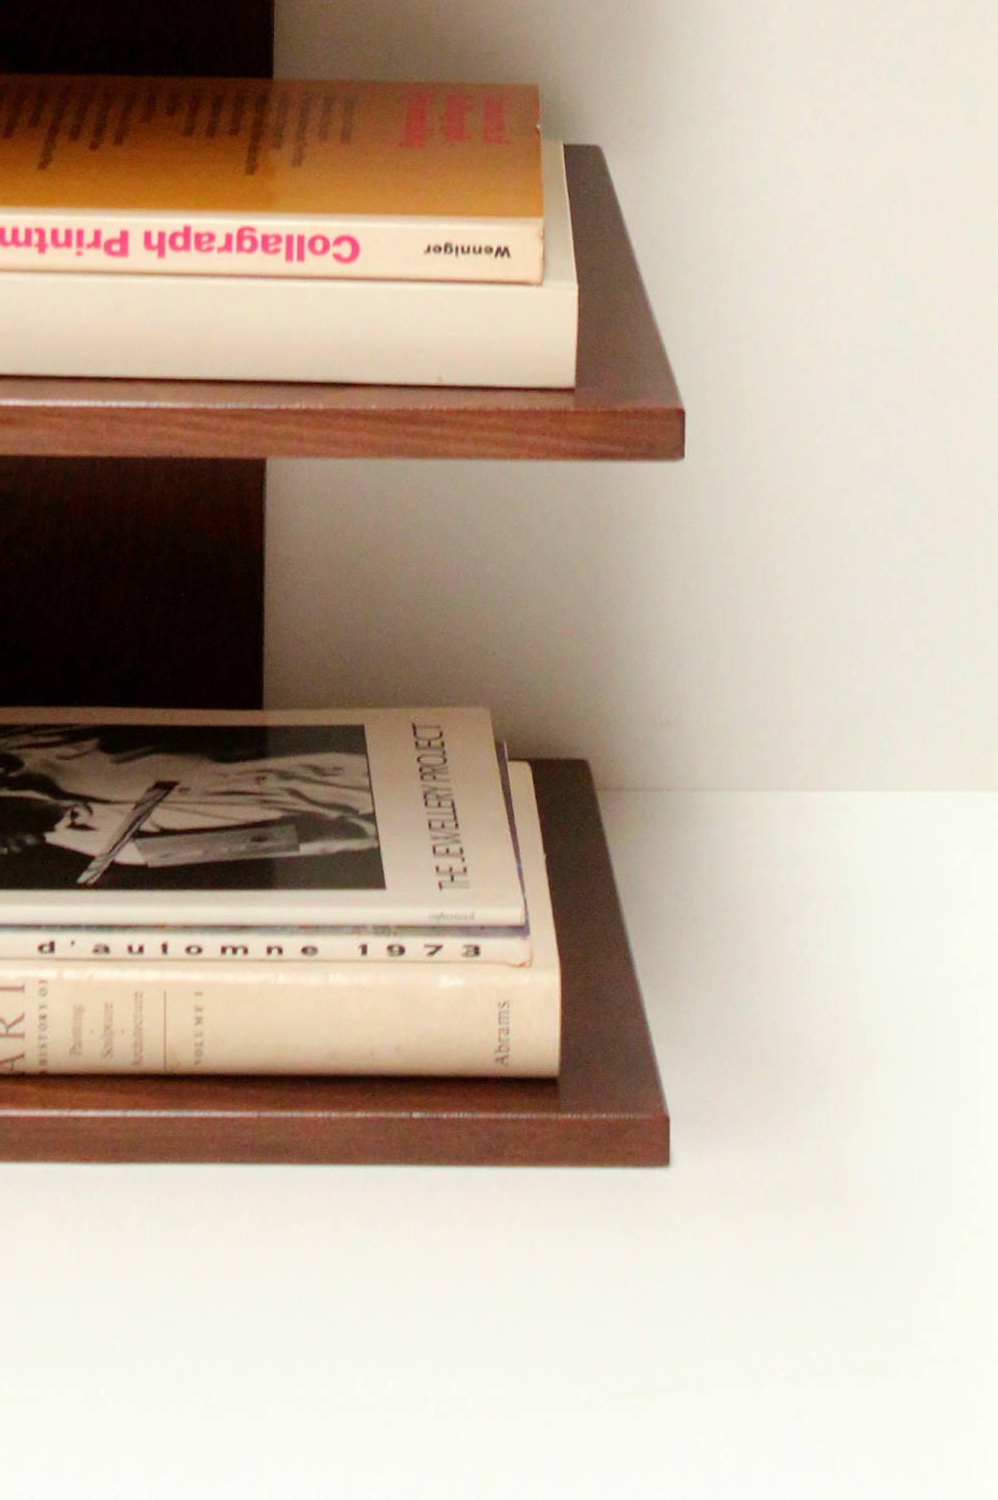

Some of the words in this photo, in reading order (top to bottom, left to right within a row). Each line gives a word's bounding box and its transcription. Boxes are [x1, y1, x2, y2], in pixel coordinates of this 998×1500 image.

[143, 229, 360, 265] Collagraph
[424, 242, 512, 260] Wenniger
[411, 722, 451, 783] PROJECT
[420, 784, 466, 863] JEWELLERY
[434, 866, 470, 891] THE
[38, 937, 320, 958] d'automne
[358, 941, 483, 958] 1973
[493, 999, 511, 1066] Abrams
